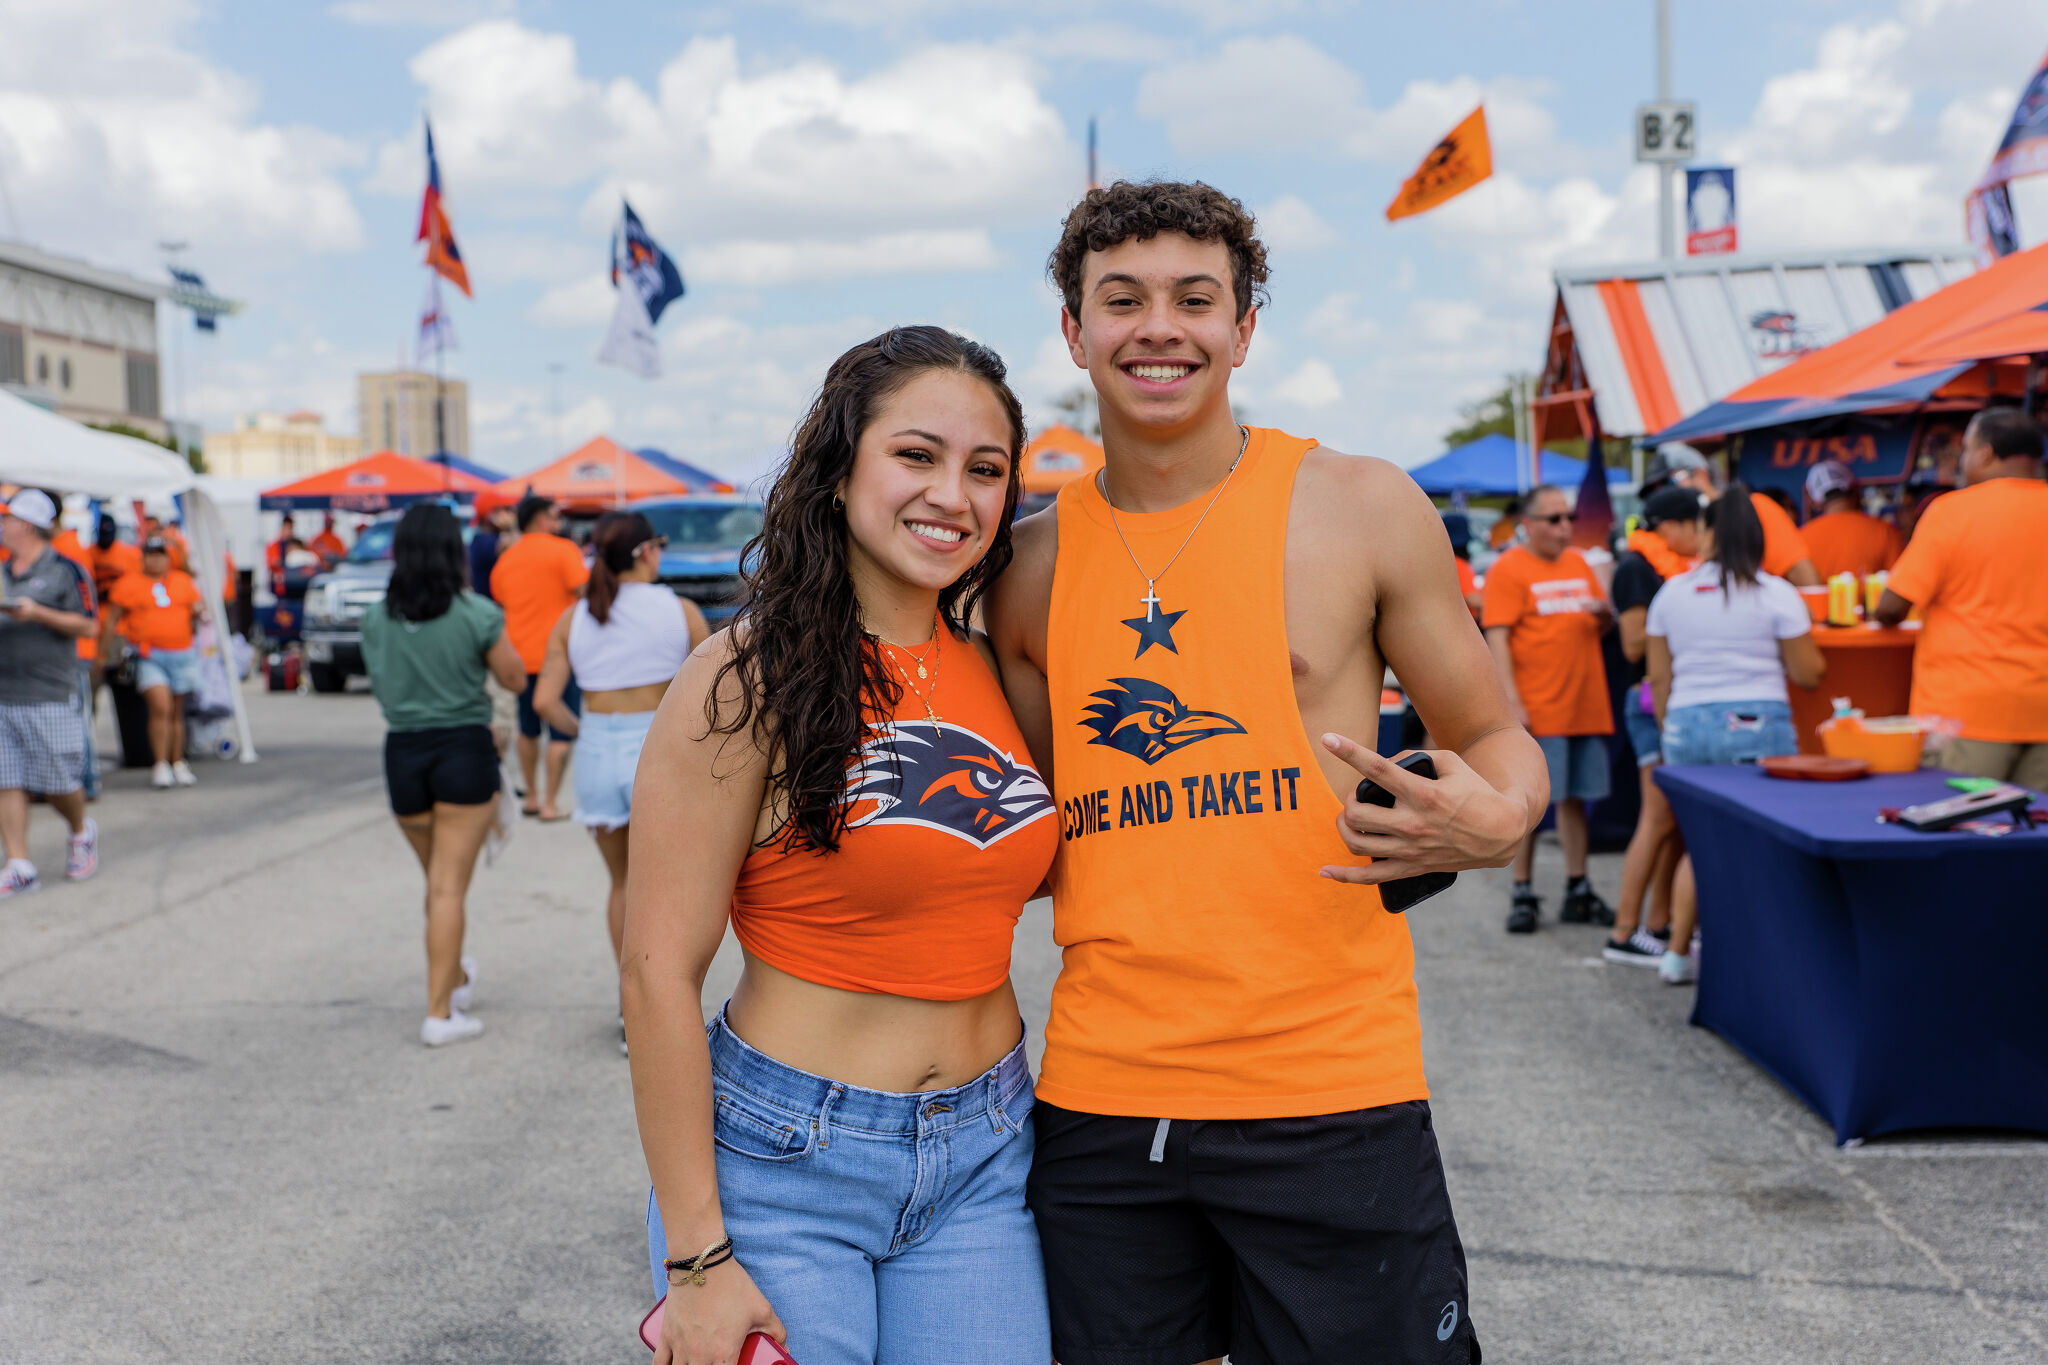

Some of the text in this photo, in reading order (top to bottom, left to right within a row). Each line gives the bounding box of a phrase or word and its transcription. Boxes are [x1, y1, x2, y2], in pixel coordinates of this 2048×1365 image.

[1772, 434, 1878, 468] UTSA
[1064, 766, 1301, 842] COME AND TAKE IT
